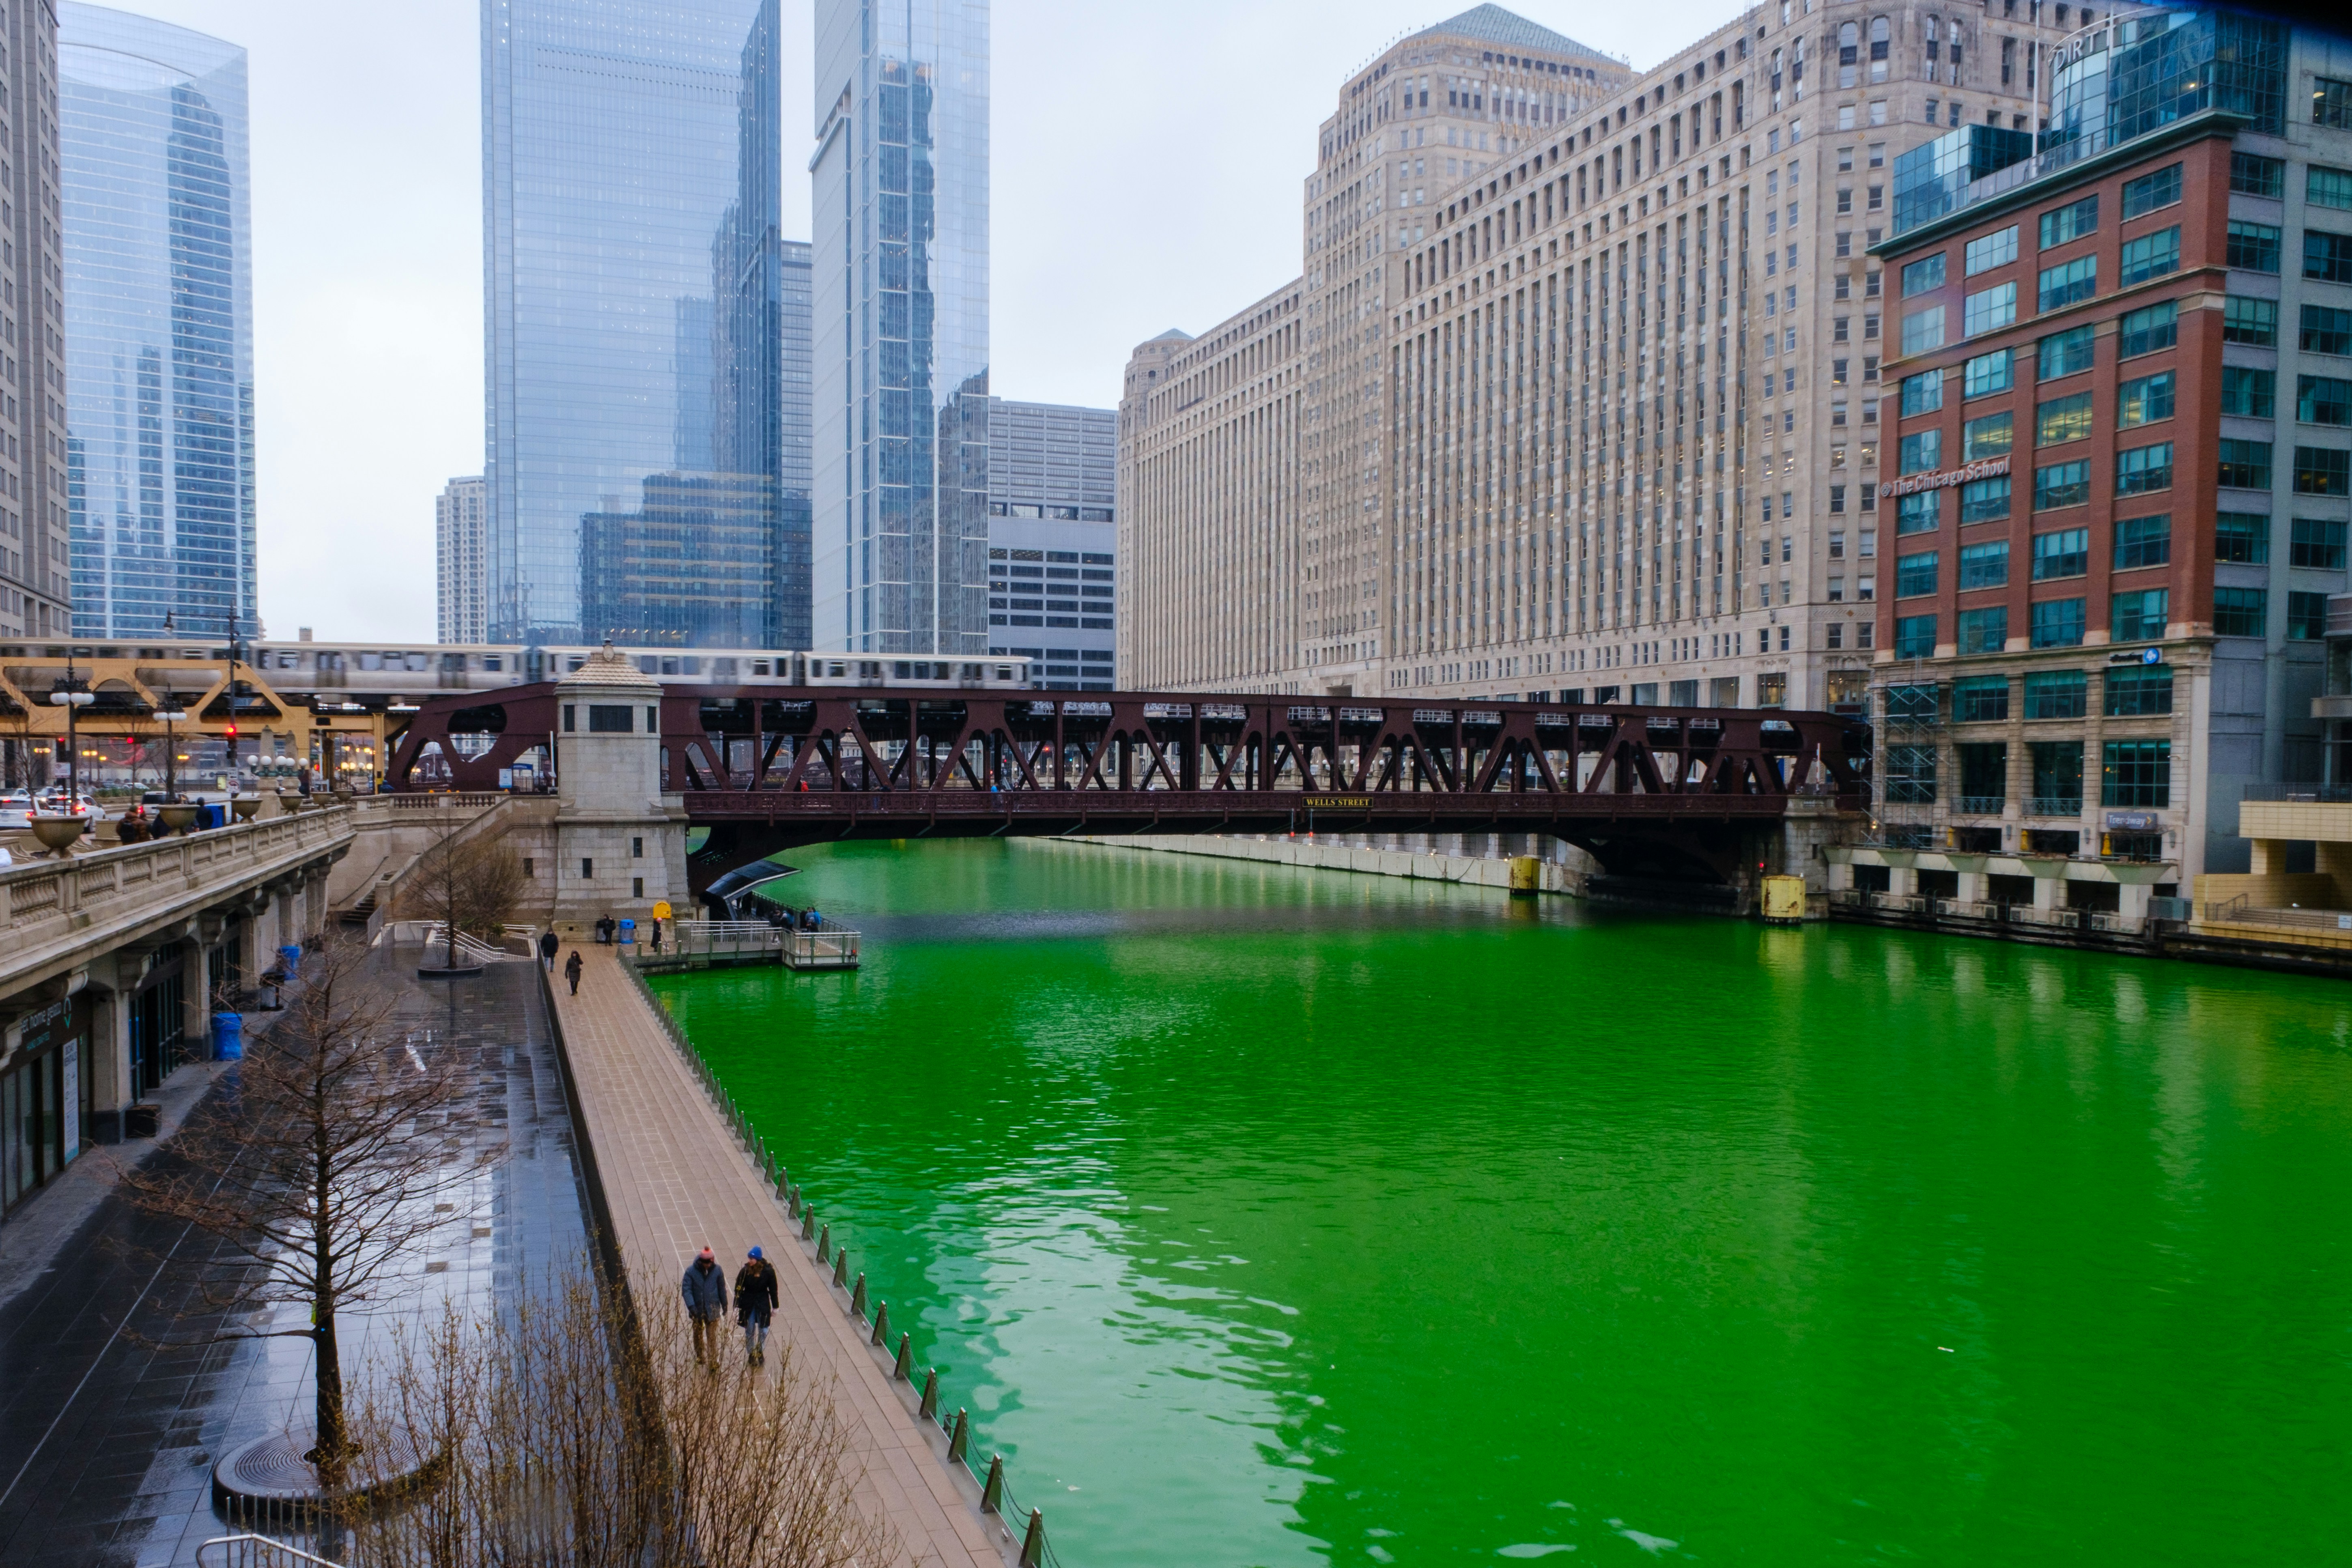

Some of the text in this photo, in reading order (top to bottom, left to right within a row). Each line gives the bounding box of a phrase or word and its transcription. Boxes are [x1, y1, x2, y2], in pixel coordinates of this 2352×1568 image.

[1893, 456, 2010, 495] The Chicago School
[2108, 815, 2145, 827] Trendway
